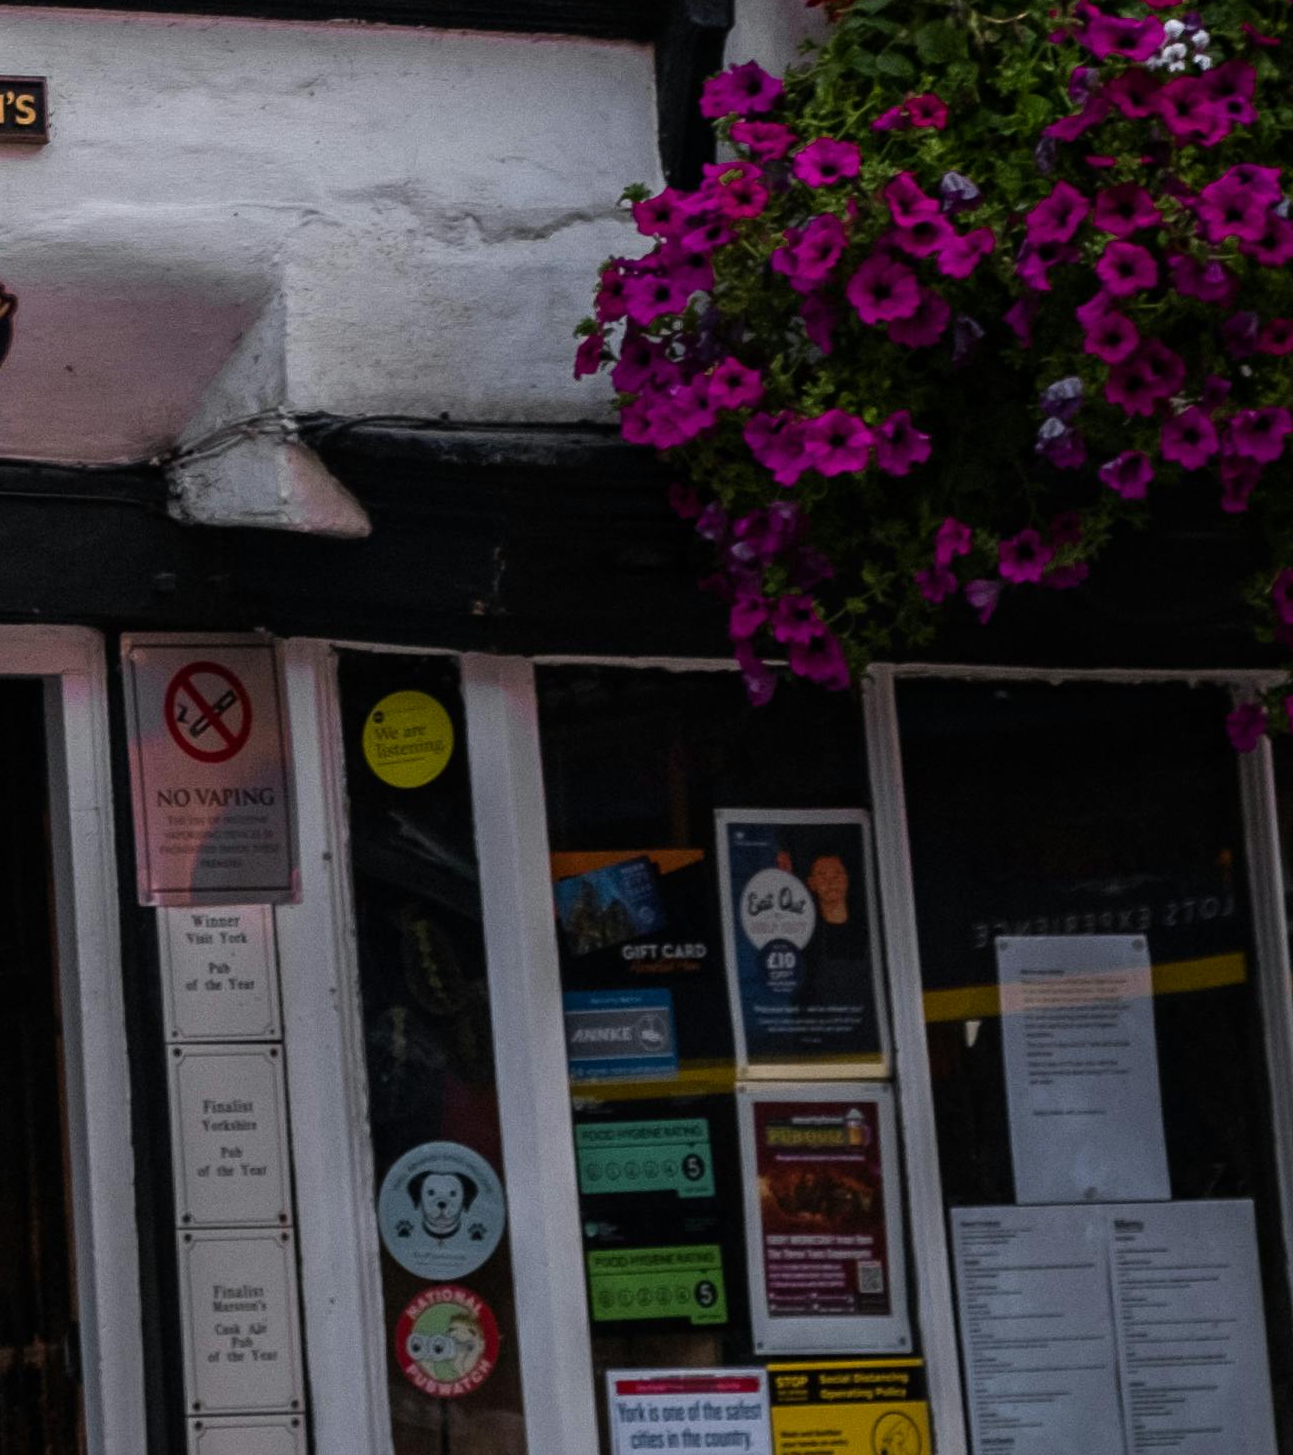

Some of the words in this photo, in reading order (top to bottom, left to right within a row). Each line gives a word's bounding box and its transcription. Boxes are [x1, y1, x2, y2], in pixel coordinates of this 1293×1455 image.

[157, 789, 191, 807] NO
[195, 787, 274, 807] VAPING
[748, 893, 774, 916] Eat
[779, 887, 807, 915] Out
[192, 915, 240, 928] Winner
[220, 932, 247, 944] York
[621, 945, 657, 960] GIFT
[662, 944, 708, 959] CARD
[209, 963, 231, 975] Pub
[186, 980, 198, 991] of
[205, 979, 222, 991] the
[229, 978, 255, 990] Year
[572, 1026, 633, 1042] ANNKE
[202, 1099, 254, 1115] Finalist
[202, 1119, 257, 1132] Yorkshire
[220, 1146, 243, 1159] Pub
[197, 1165, 210, 1178] of
[217, 1164, 234, 1177] the
[240, 1164, 268, 1177] Year
[686, 1156, 699, 1178] 5
[212, 1285, 264, 1300] Finalist
[699, 1283, 713, 1305] 5
[404, 1288, 484, 1319] NATIONAL
[231, 1336, 254, 1349] Pub
[207, 1351, 221, 1364] of
[226, 1350, 244, 1363] the
[251, 1349, 278, 1362] Year
[405, 1358, 494, 1397] PUBWATCH
[617, 1402, 646, 1423] York
[649, 1404, 660, 1422] is
[663, 1406, 686, 1422] one
[688, 1401, 701, 1422] of
[703, 1402, 723, 1421] the
[725, 1401, 762, 1421] safest
[631, 1430, 664, 1449] cities
[668, 1430, 679, 1449] in
[682, 1428, 702, 1448] the
